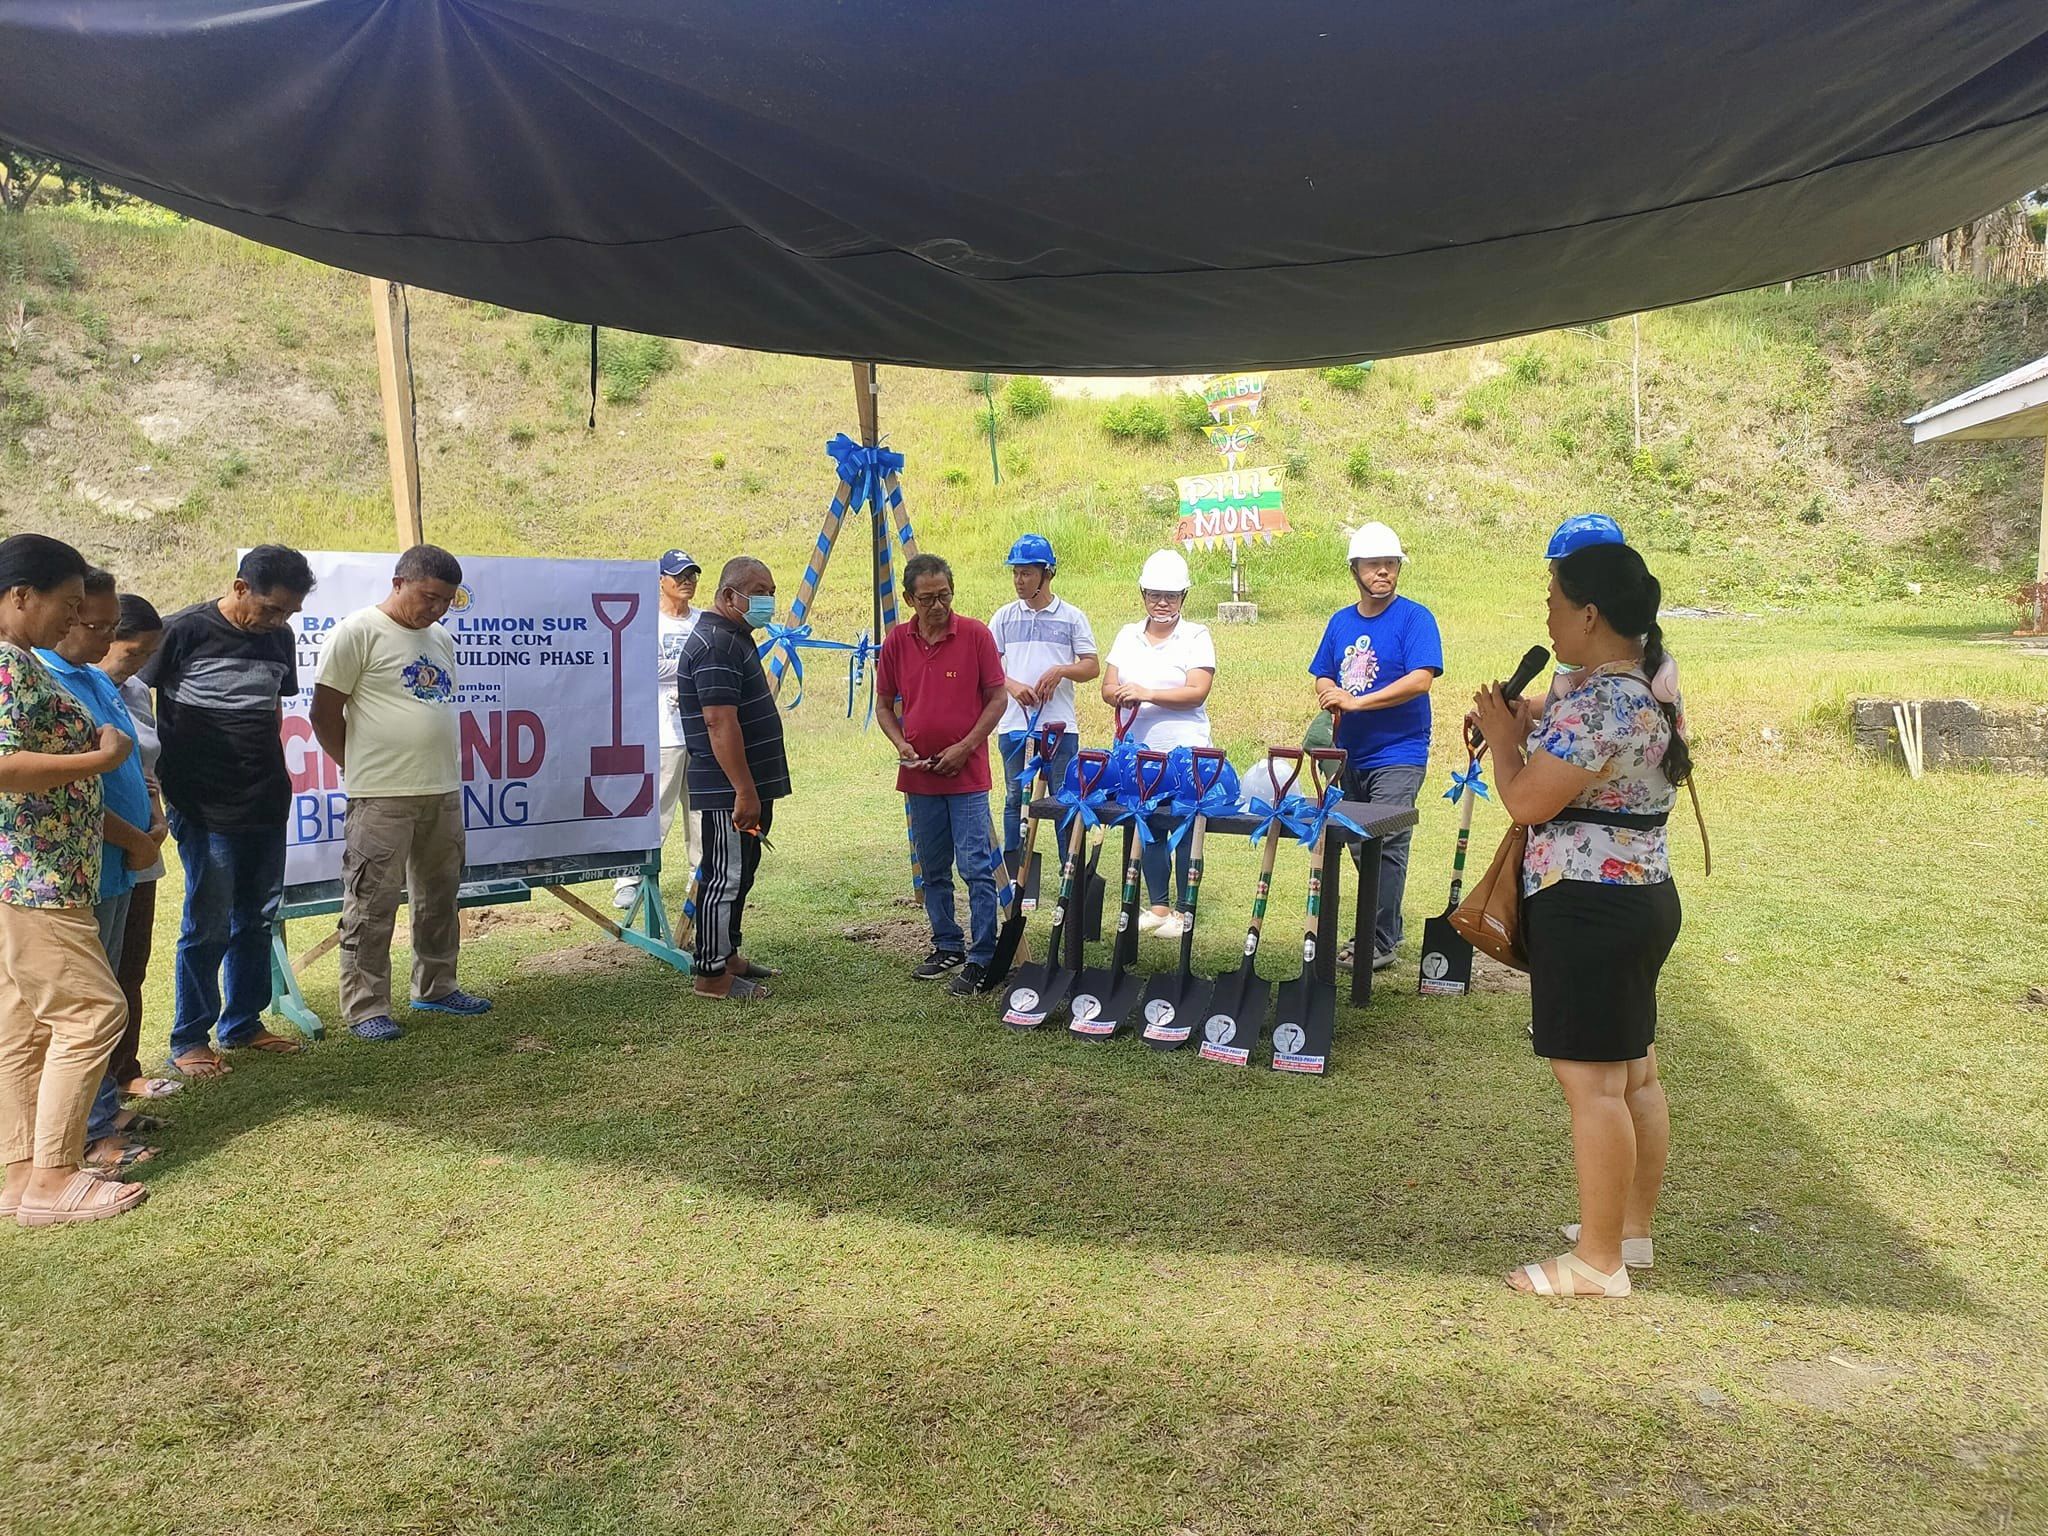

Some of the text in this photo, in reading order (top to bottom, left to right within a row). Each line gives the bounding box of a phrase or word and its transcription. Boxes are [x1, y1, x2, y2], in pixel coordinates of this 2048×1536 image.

[1192, 505, 1264, 537] MON
[458, 618, 534, 631] LIMON
[542, 618, 588, 631] SUR
[450, 634, 553, 646] NTER CUM
[456, 651, 609, 666] UILDING PHASE 1
[458, 682, 501, 691] ombon
[471, 694, 501, 703] P.M.
[578, 869, 604, 881] JOHN
